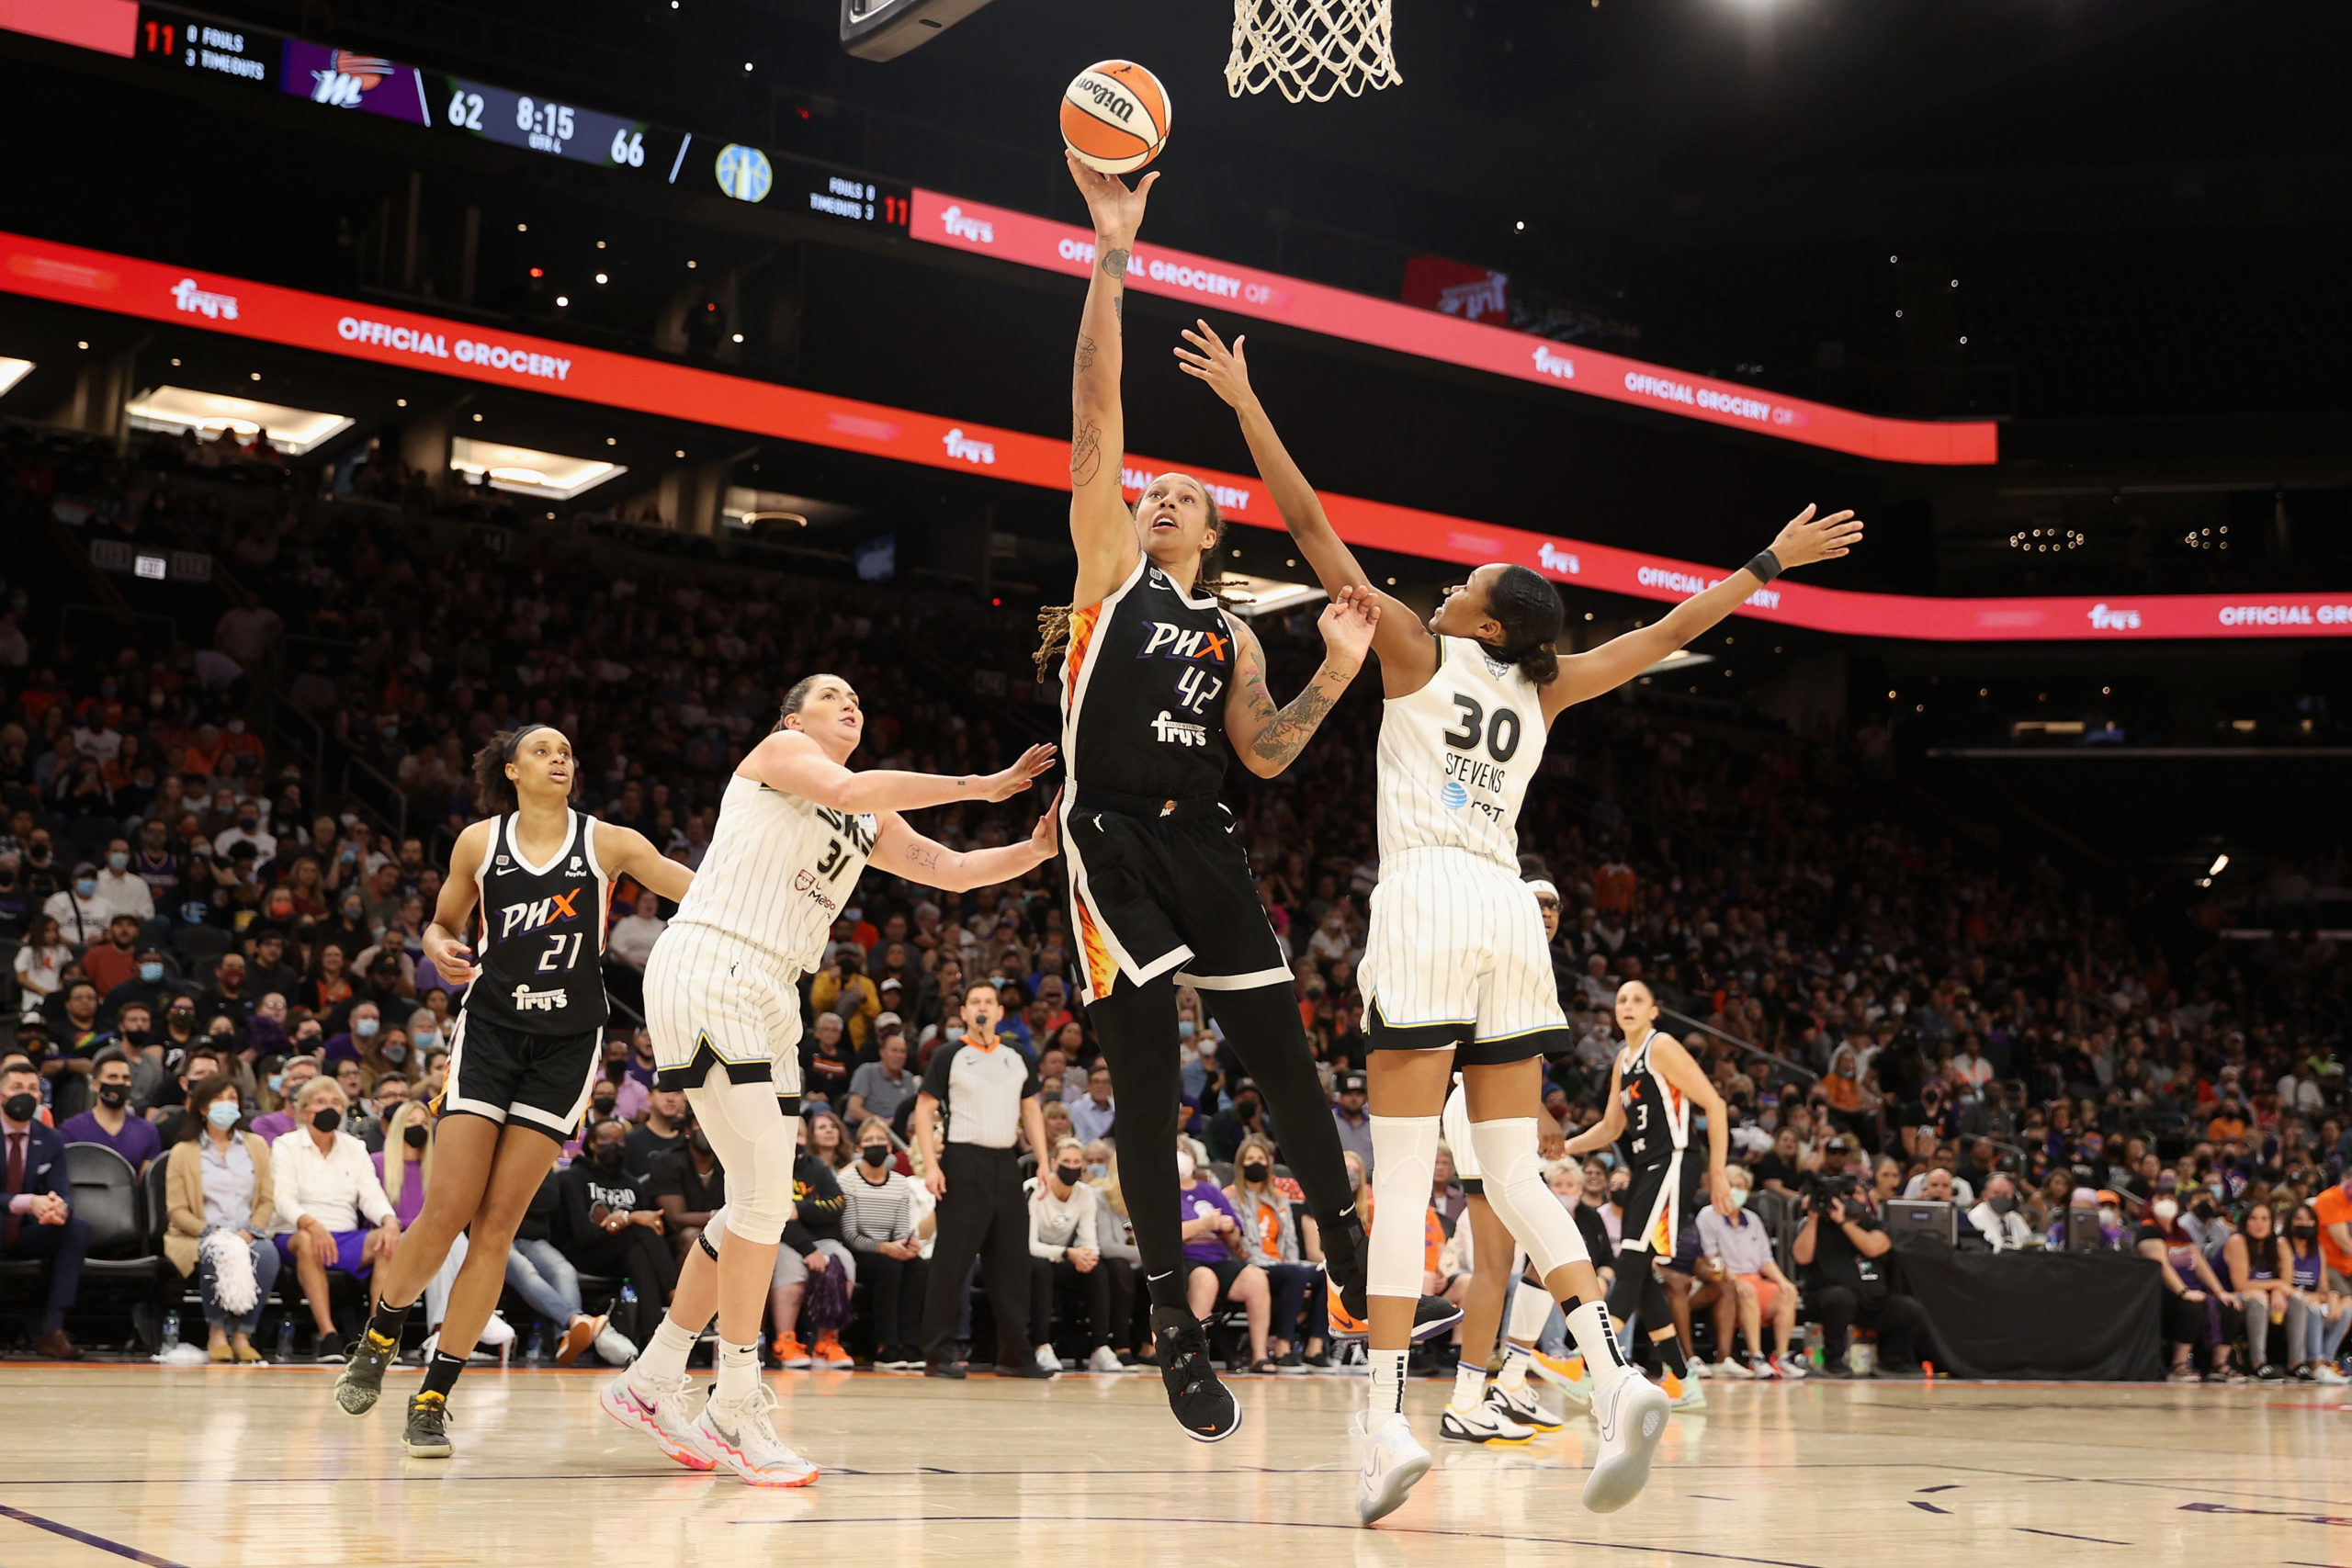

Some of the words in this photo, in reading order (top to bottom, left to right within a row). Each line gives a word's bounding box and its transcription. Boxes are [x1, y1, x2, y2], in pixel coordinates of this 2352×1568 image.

[144, 20, 175, 56] 11
[201, 27, 244, 52] FOULS
[185, 48, 196, 67] 3
[200, 49, 265, 81] TIMEOUTS
[447, 90, 484, 130] 62
[516, 96, 575, 140] 8:15
[1076, 77, 1134, 123] Wilson
[611, 129, 645, 167] 66
[808, 192, 863, 220] TIMEOUTS
[865, 203, 875, 220] 3
[829, 176, 864, 199] FOULS
[884, 196, 908, 226] 11
[1148, 259, 1242, 299] GROCERY
[337, 317, 449, 358] OFFICIAL
[454, 339, 571, 380] GROCERY
[1624, 372, 1695, 405] OFFICIAL
[1696, 389, 1770, 422] GROCERY
[1637, 566, 1705, 595] OFFICIAL
[2218, 605, 2314, 626] OFFICIAL
[1142, 621, 1229, 663] PHX
[1178, 665, 1224, 715] 42
[1150, 710, 1206, 747] fry's
[1442, 691, 1521, 763] 30
[1445, 752, 1505, 794] STEVENS
[817, 835, 854, 884] 31
[496, 887, 582, 940] PHX
[537, 932, 583, 974] 21
[511, 984, 568, 1011] fry's
[1636, 1104, 1648, 1130] 3
